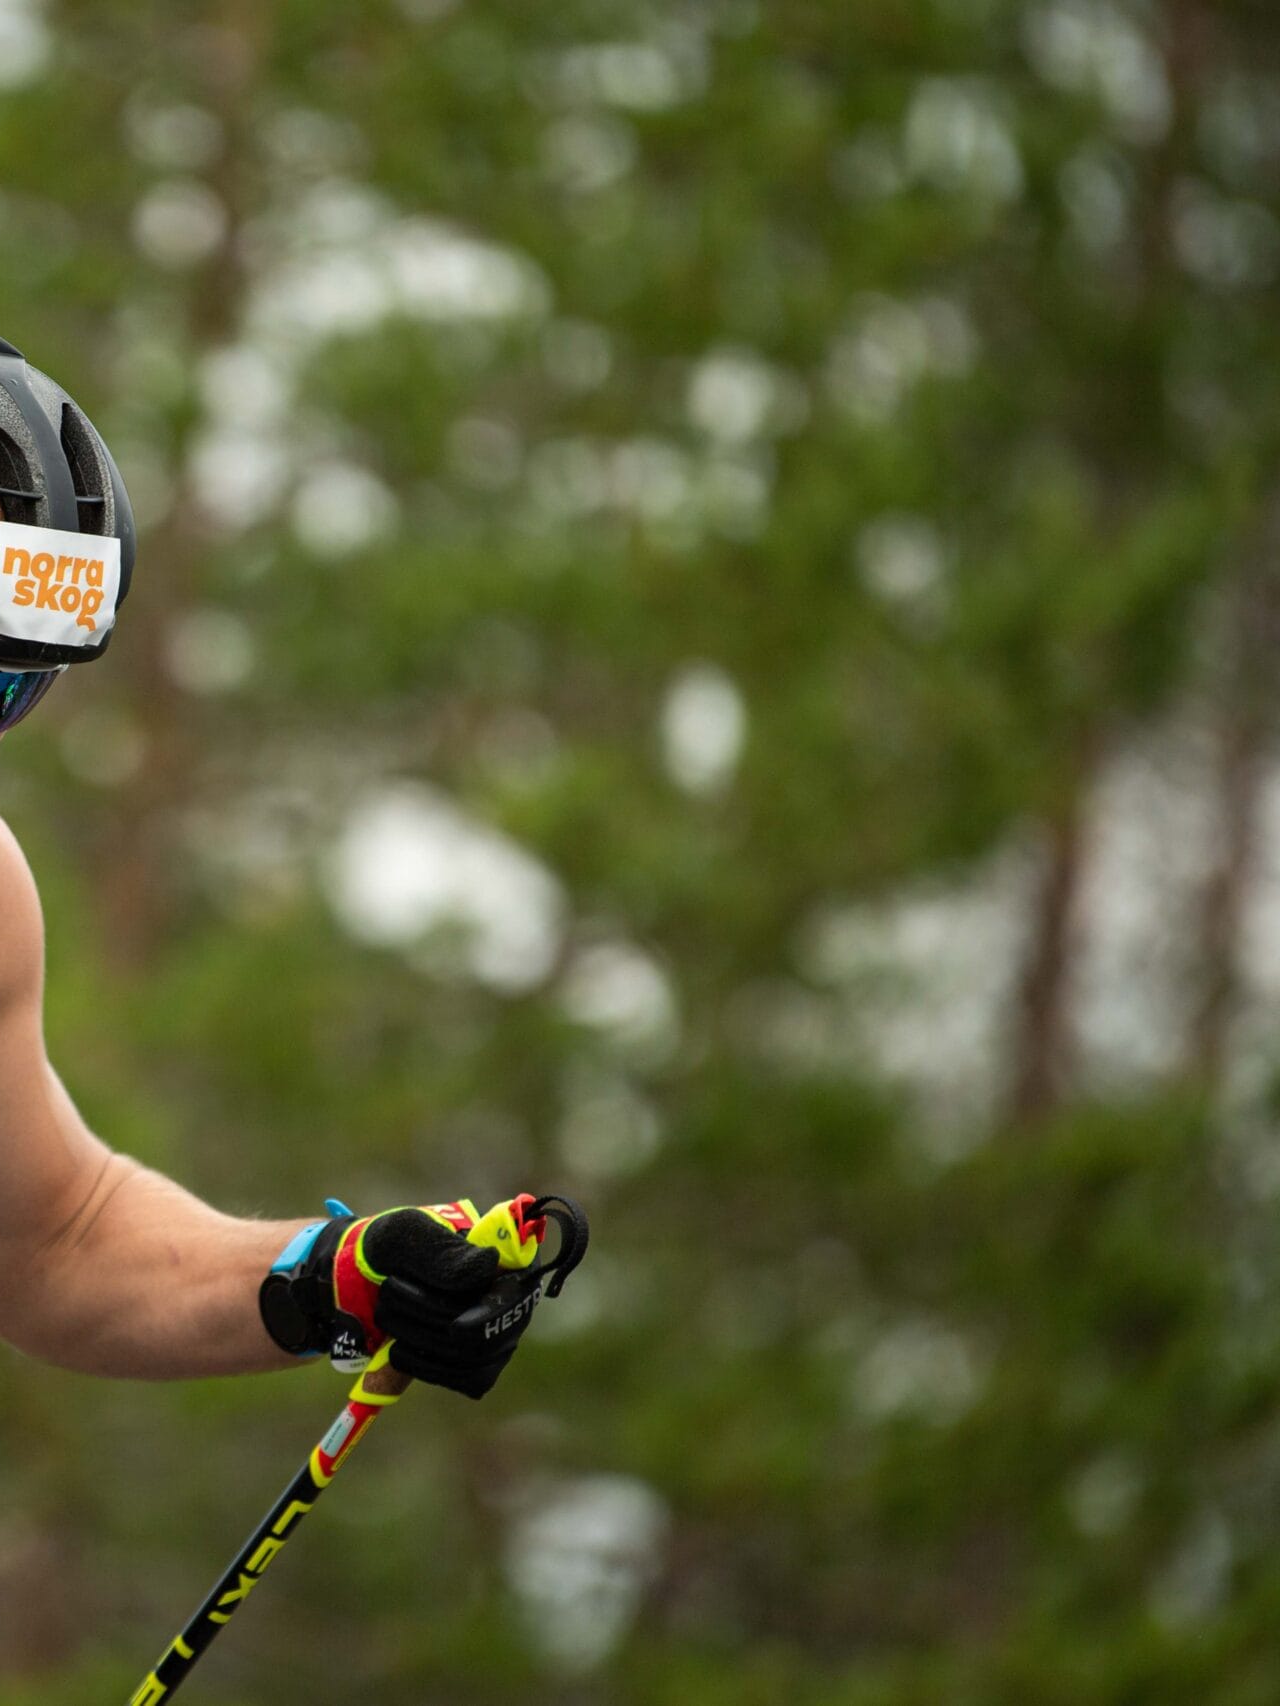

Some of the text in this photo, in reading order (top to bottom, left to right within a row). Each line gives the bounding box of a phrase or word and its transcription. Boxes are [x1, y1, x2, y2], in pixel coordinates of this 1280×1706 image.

[2, 547, 105, 588] norra
[12, 576, 105, 632] skog
[484, 1280, 543, 1340] HESTR
